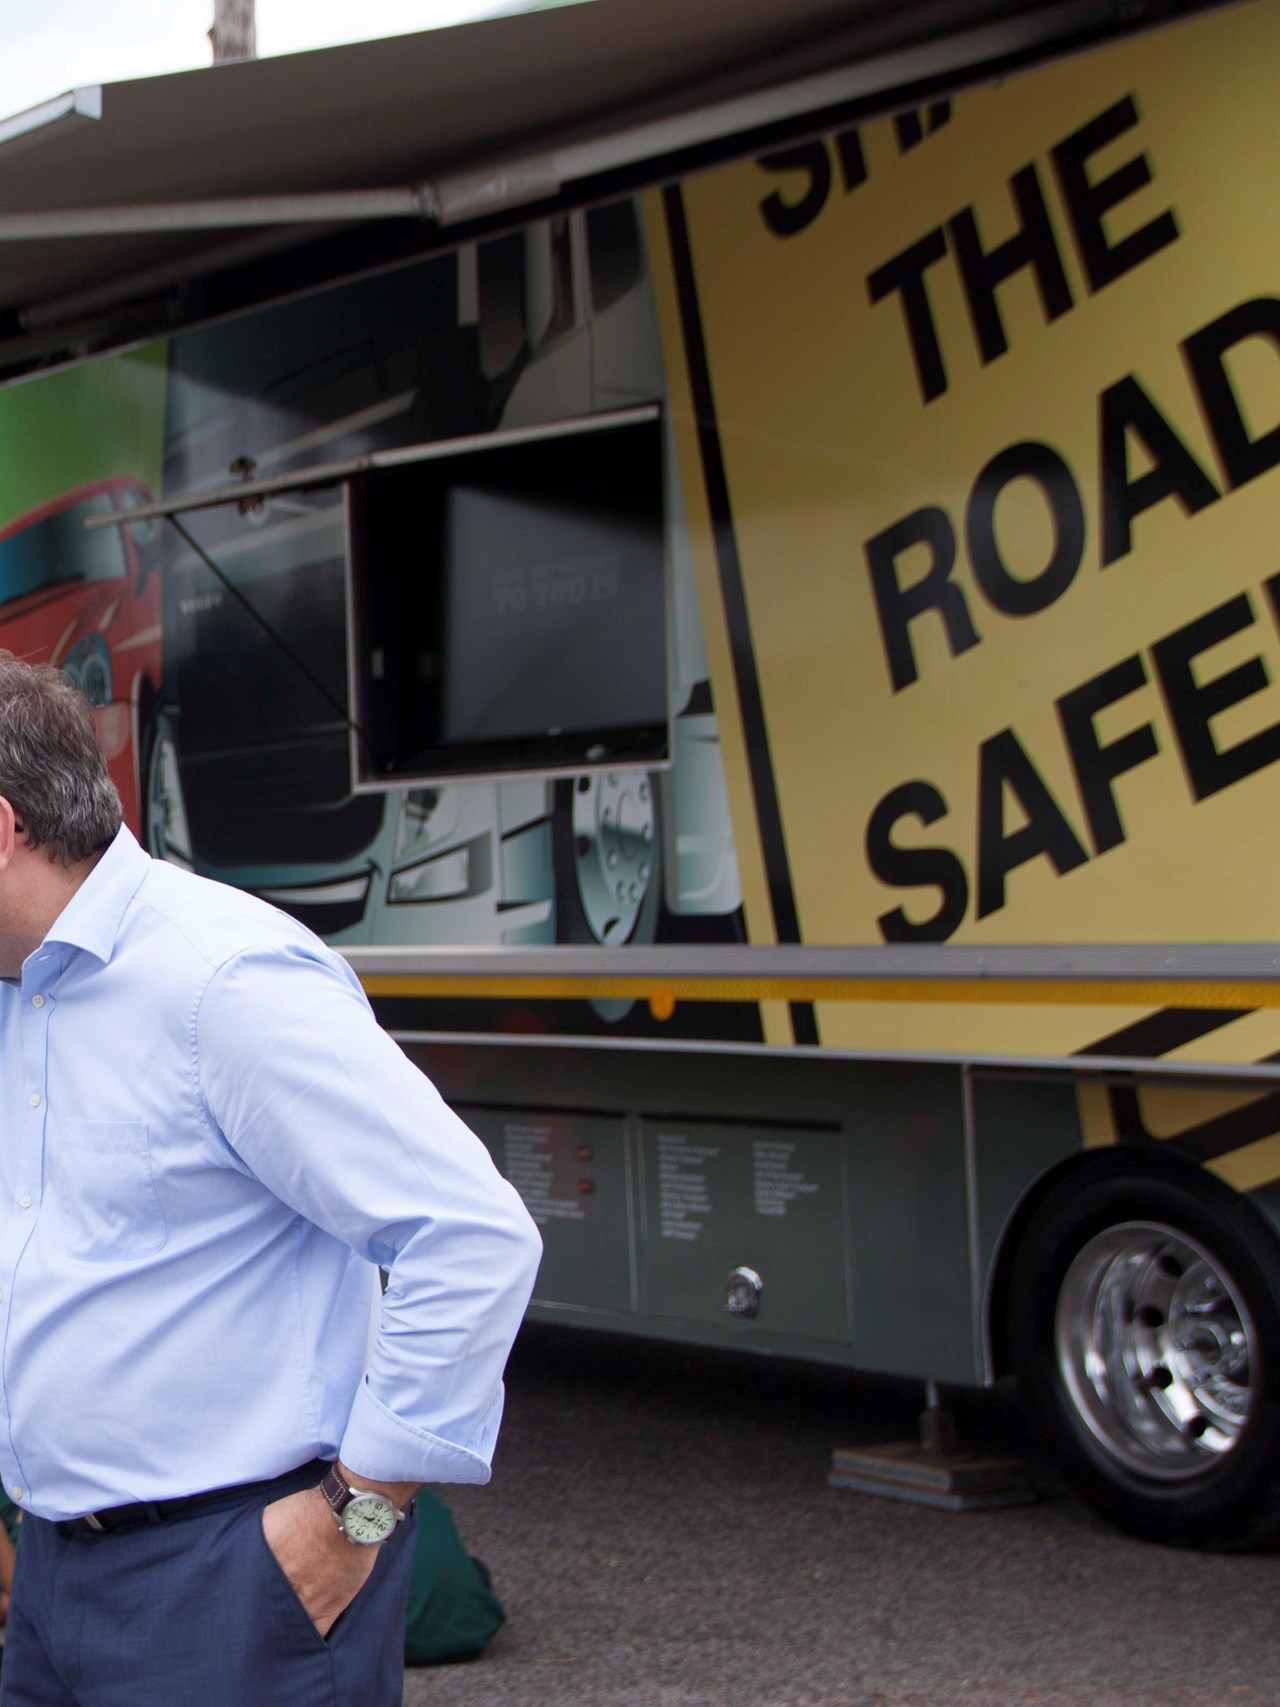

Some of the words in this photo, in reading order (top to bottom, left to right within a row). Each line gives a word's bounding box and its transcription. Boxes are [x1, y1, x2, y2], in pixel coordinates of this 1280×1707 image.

[867, 89, 1181, 407] THE
[863, 296, 1280, 696] ROAD
[864, 569, 1280, 946] SAFE
